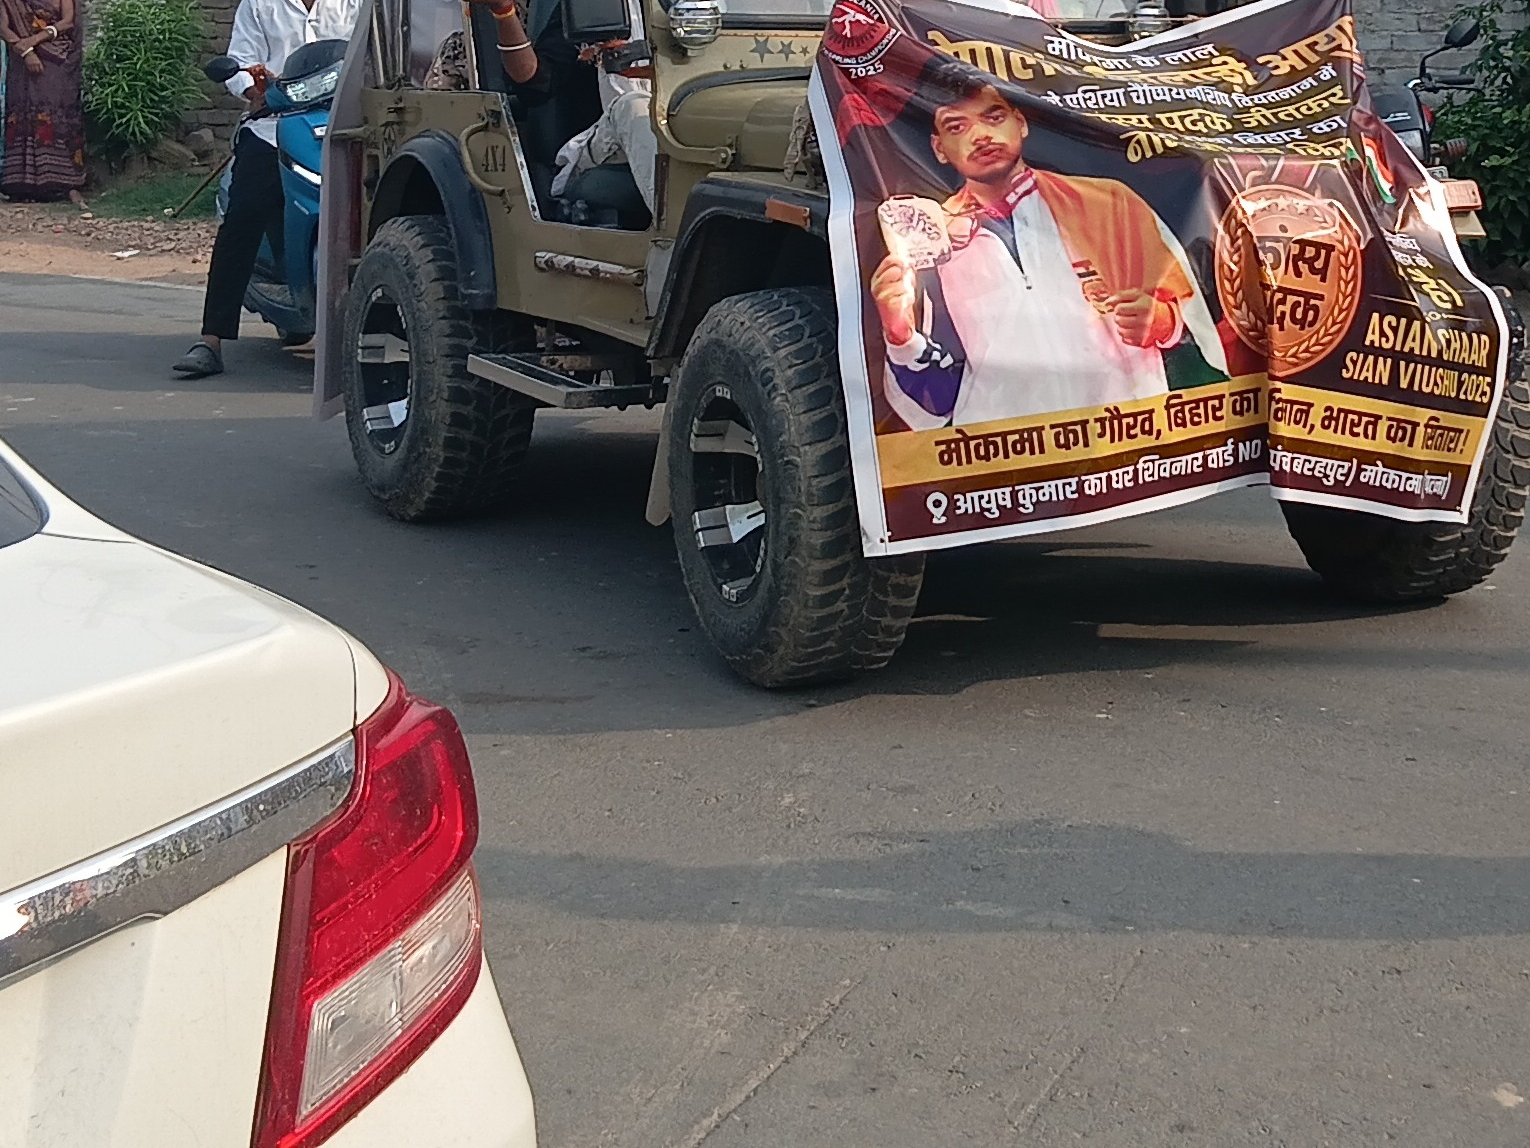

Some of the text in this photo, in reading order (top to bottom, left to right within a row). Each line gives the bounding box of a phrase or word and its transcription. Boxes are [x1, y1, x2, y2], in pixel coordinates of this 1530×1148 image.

[848, 60, 884, 80] 2025
[1128, 54, 1160, 68] के
[1158, 43, 1221, 65] लाल
[1155, 108, 1233, 133] पदक
[1233, 84, 1352, 129] जीतकर
[1306, 115, 1348, 134] का
[1364, 312, 1439, 359] ASIAN
[1342, 351, 1393, 386] SIAN
[1459, 372, 1493, 404] 2025
[935, 427, 1046, 467] मोकामा
[1050, 418, 1090, 451] का
[1093, 405, 1162, 444] गौरव,
[1163, 393, 1226, 432] बिहार
[1229, 387, 1262, 418] का
[1320, 405, 1383, 442] भारत
[1386, 416, 1420, 448] का
[953, 486, 1013, 519] आयुष
[1014, 476, 1079, 514] कुमार
[1080, 471, 1109, 497] का
[1109, 465, 1135, 490] घर
[1136, 454, 1206, 485] शिवनार
[1206, 437, 1235, 469] वार्ड
